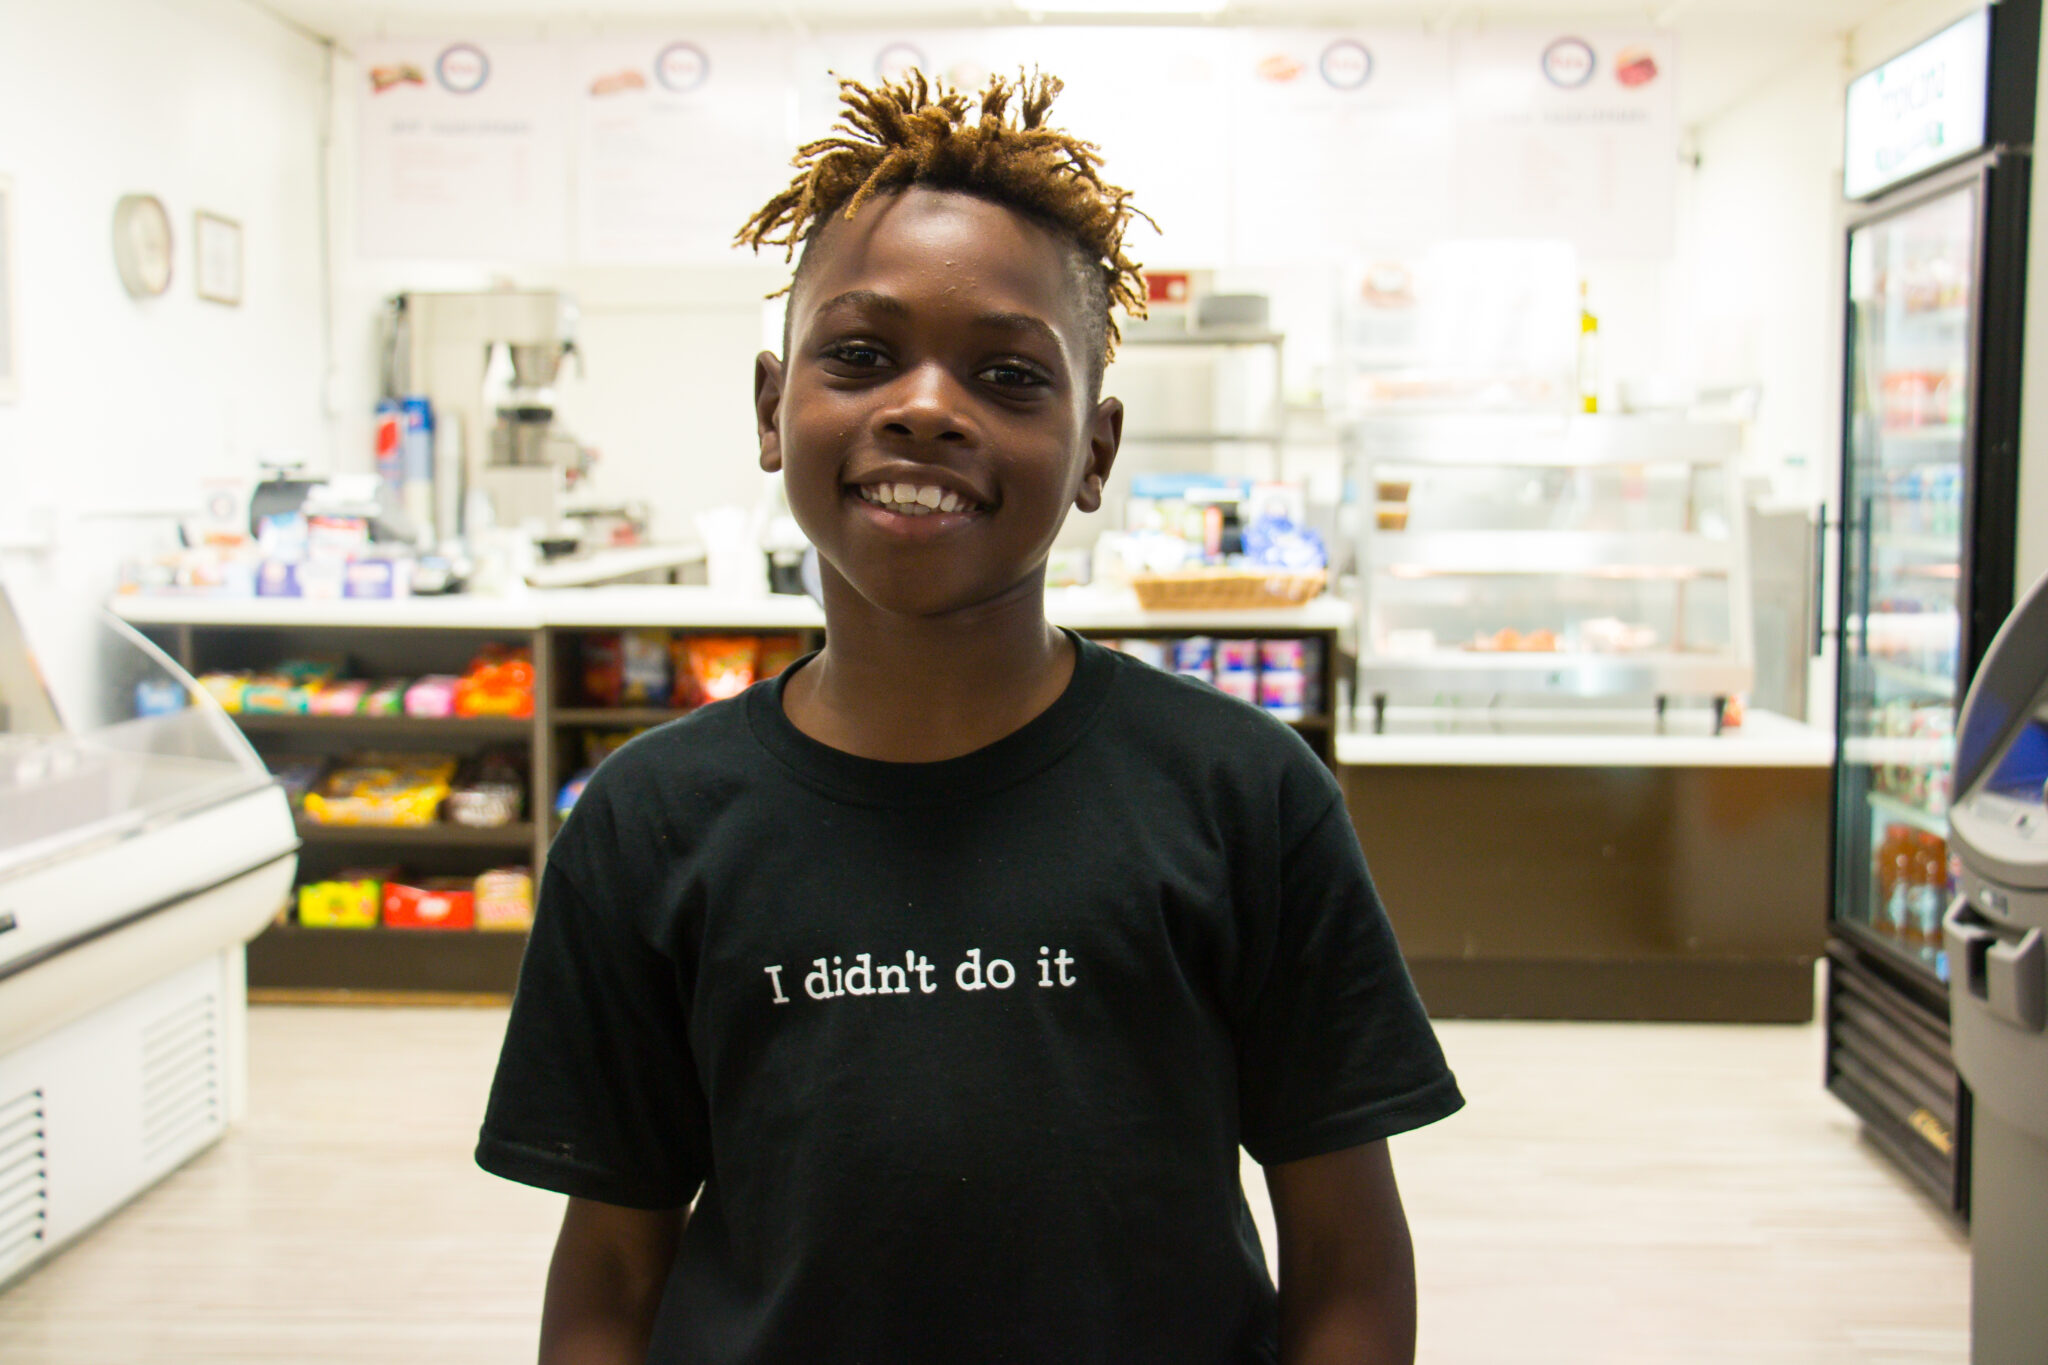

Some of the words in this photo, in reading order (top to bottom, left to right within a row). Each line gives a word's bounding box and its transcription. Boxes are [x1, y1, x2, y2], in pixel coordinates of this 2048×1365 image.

[764, 965, 789, 1003] I
[805, 950, 937, 999] didn't
[956, 948, 1015, 991] do
[1037, 946, 1076, 986] it
